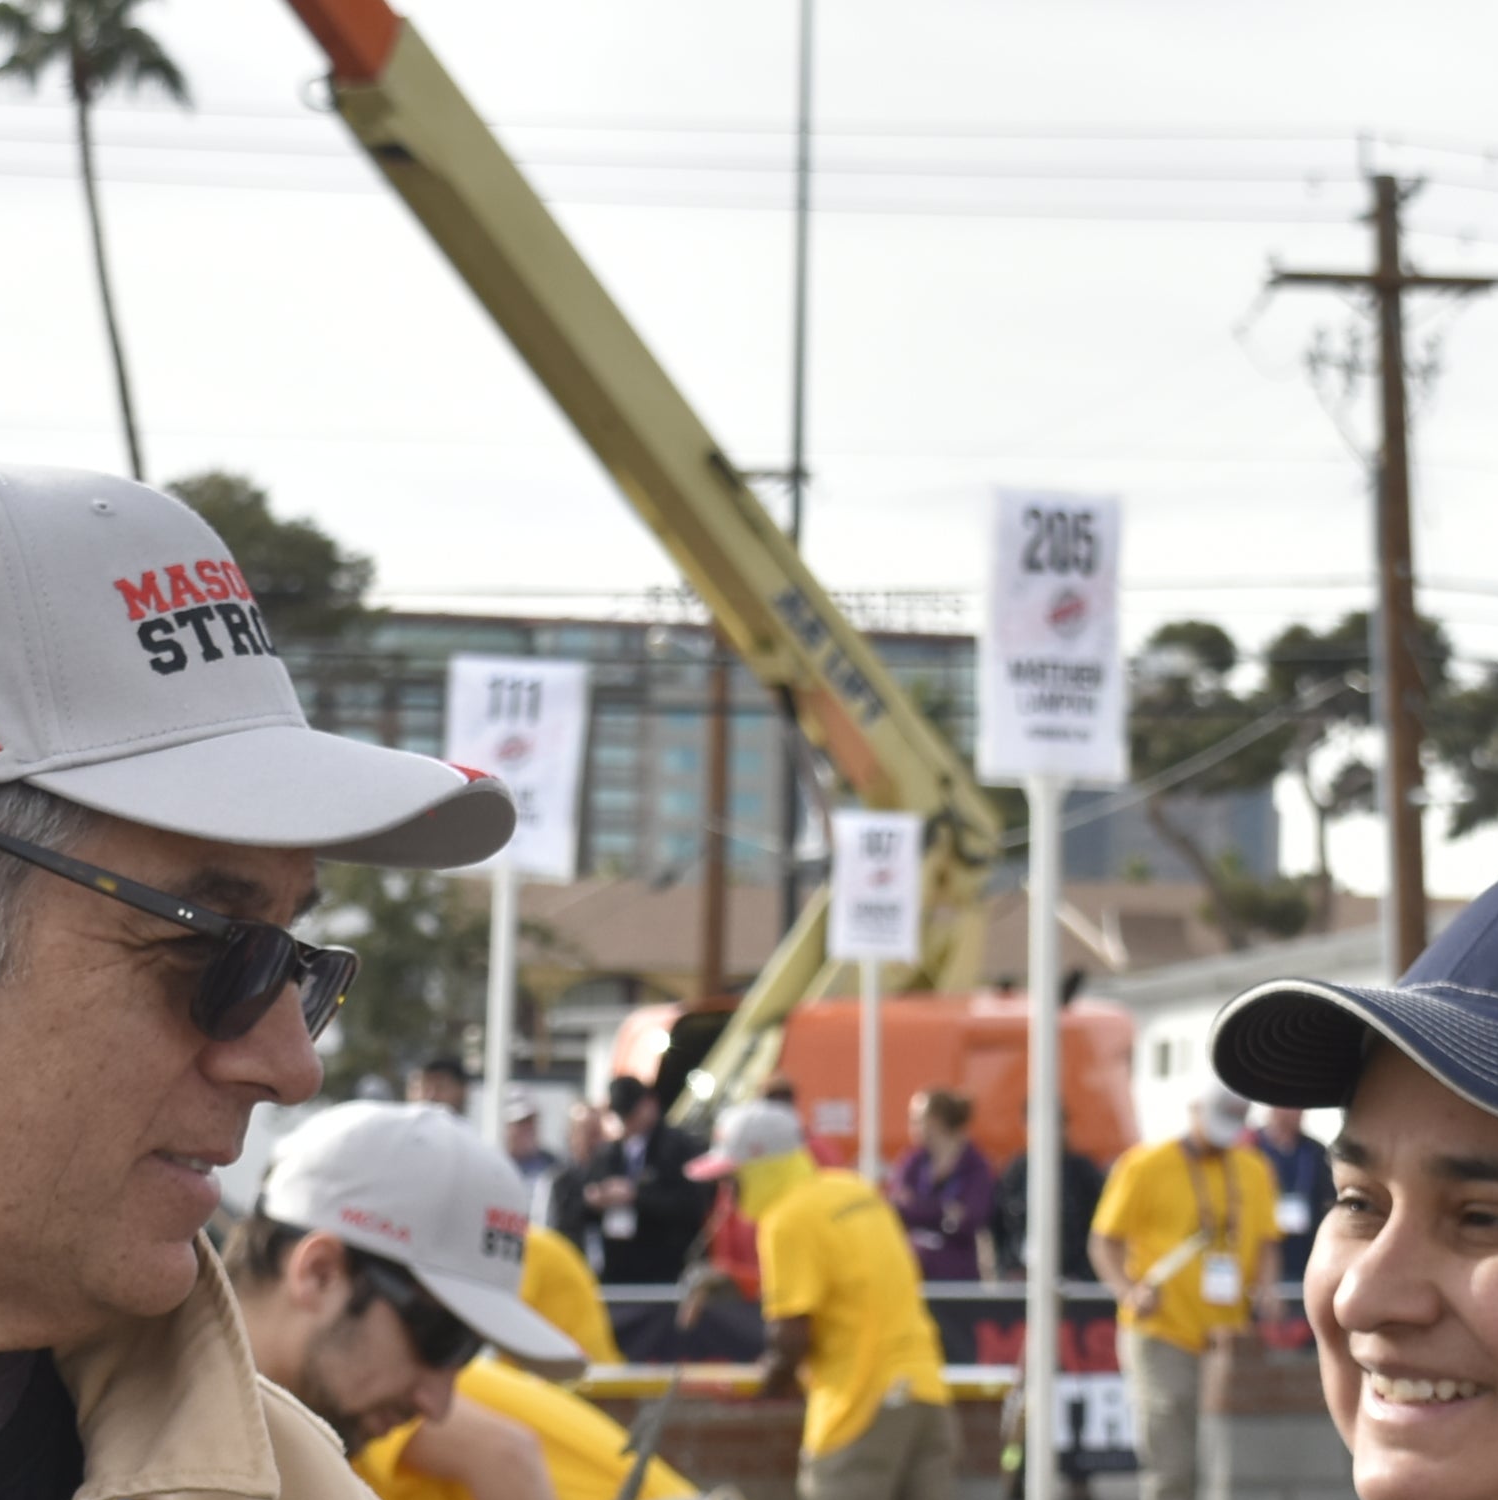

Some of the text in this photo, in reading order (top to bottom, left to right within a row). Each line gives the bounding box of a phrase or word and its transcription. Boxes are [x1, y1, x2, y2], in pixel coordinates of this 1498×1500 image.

[1022, 507, 1096, 577] 205
[113, 560, 258, 622] MASO
[486, 675, 542, 724] 111
